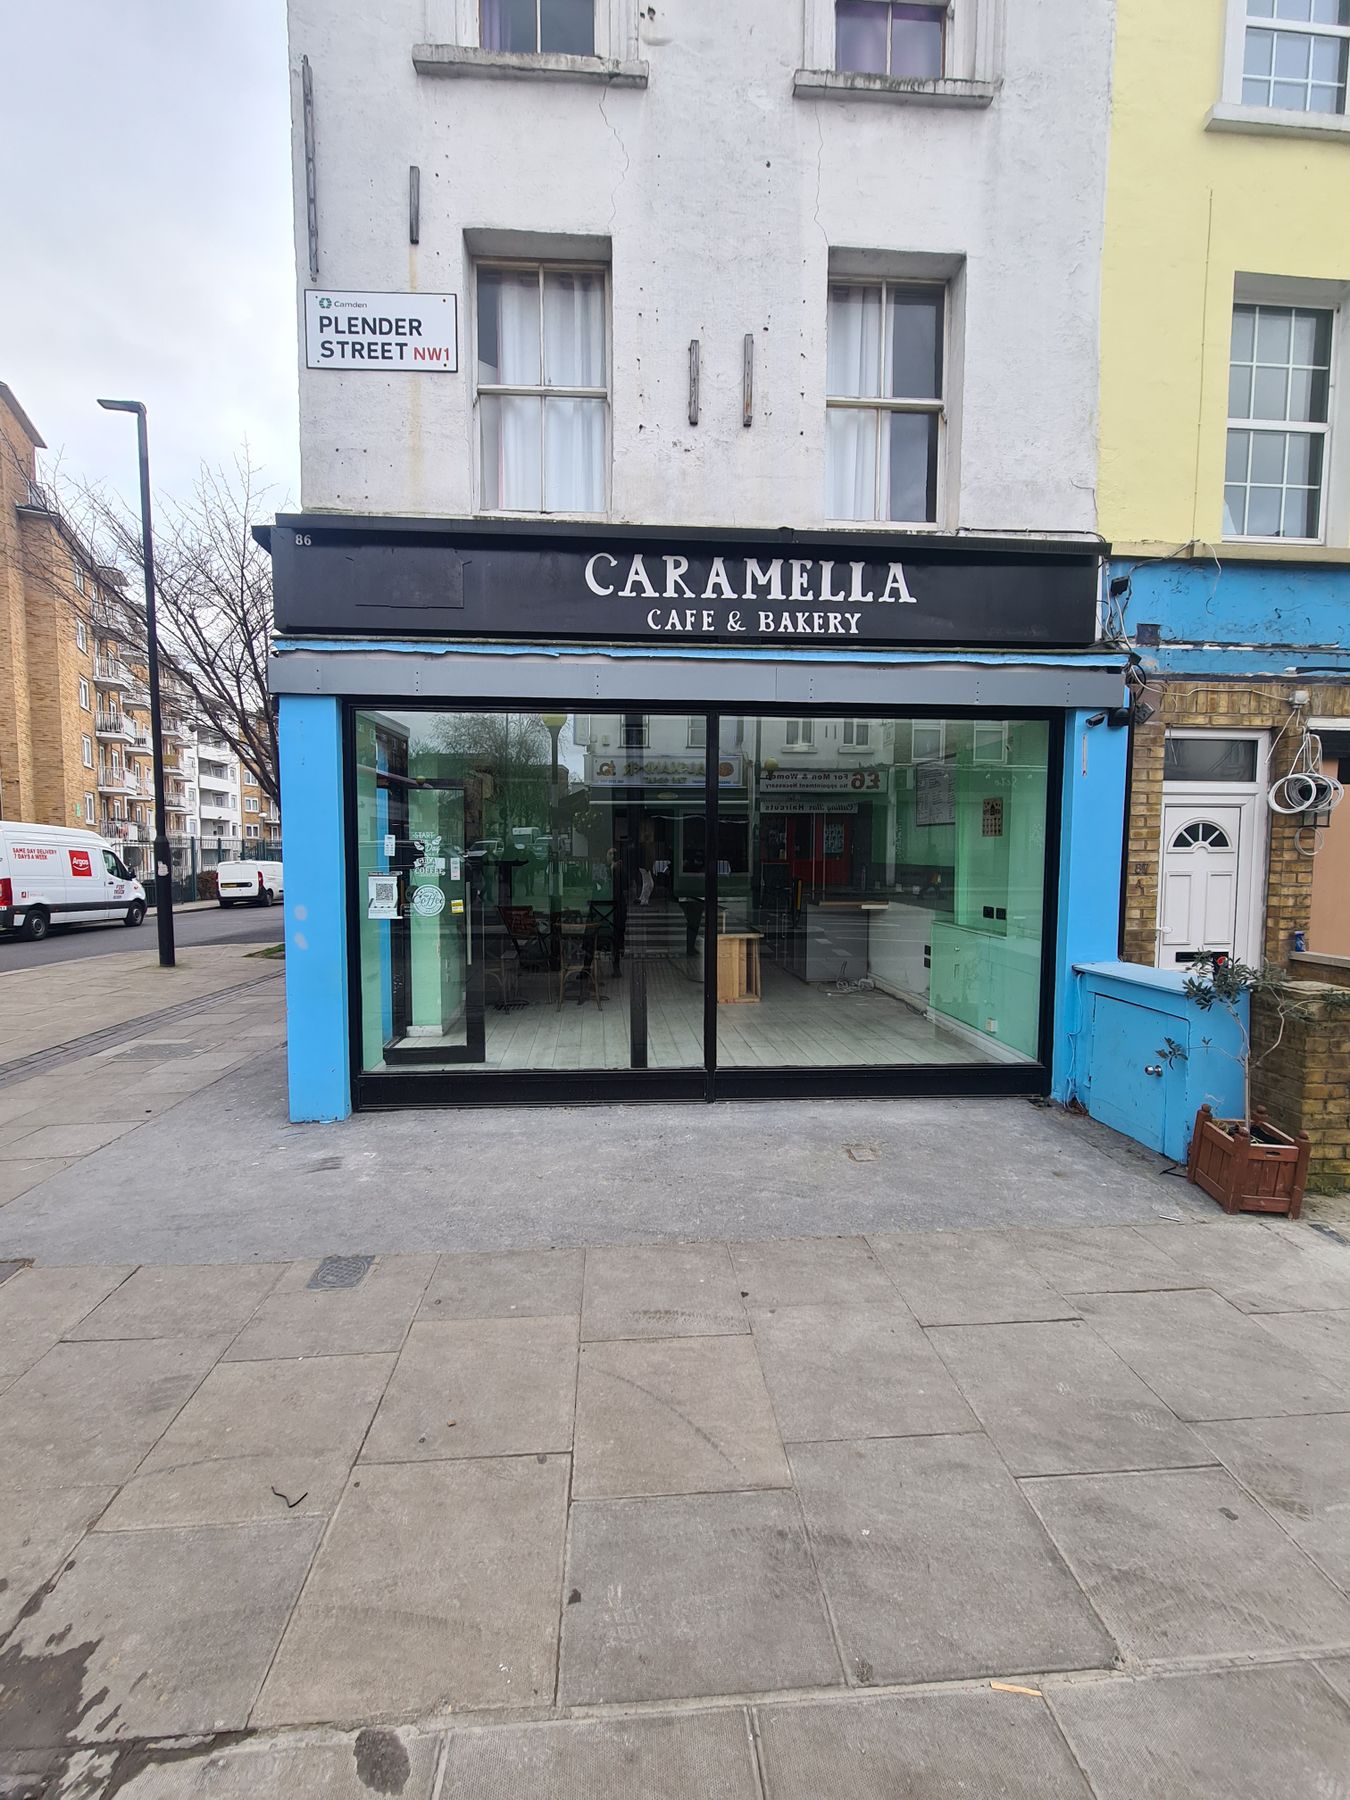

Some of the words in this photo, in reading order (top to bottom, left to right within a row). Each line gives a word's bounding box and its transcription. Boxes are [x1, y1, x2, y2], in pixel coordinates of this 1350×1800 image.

[333, 300, 368, 309] Camden
[319, 315, 423, 337] PLENDER
[320, 340, 408, 360] STREET
[413, 346, 450, 361] NW1
[295, 534, 312, 546] 86
[584, 552, 917, 603] CARAMELLA
[647, 608, 715, 632] CAFE
[727, 610, 746, 631] &
[758, 611, 862, 634] BAKERY
[72, 856, 89, 867] Argos
